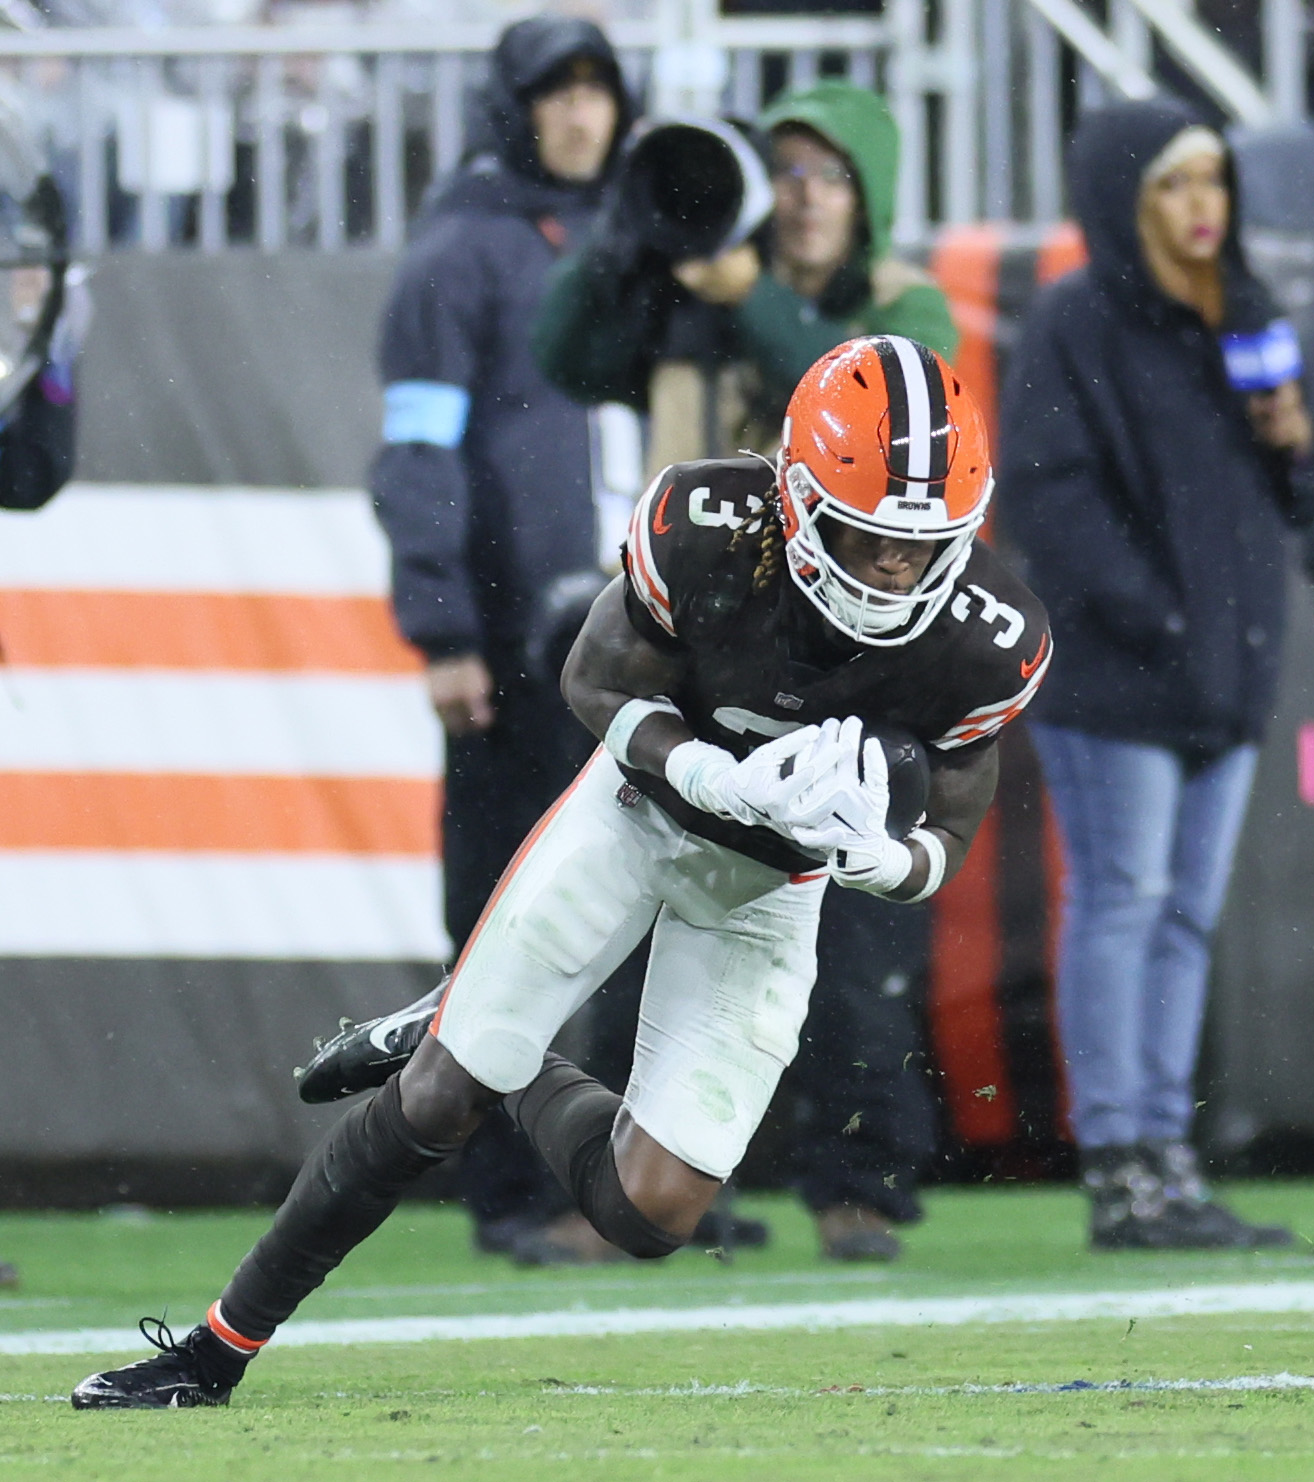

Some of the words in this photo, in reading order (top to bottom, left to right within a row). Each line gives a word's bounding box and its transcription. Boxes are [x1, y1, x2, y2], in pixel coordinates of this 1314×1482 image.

[689, 486, 764, 534] 3
[897, 500, 932, 511] BROWNS
[950, 584, 1025, 649] 3
